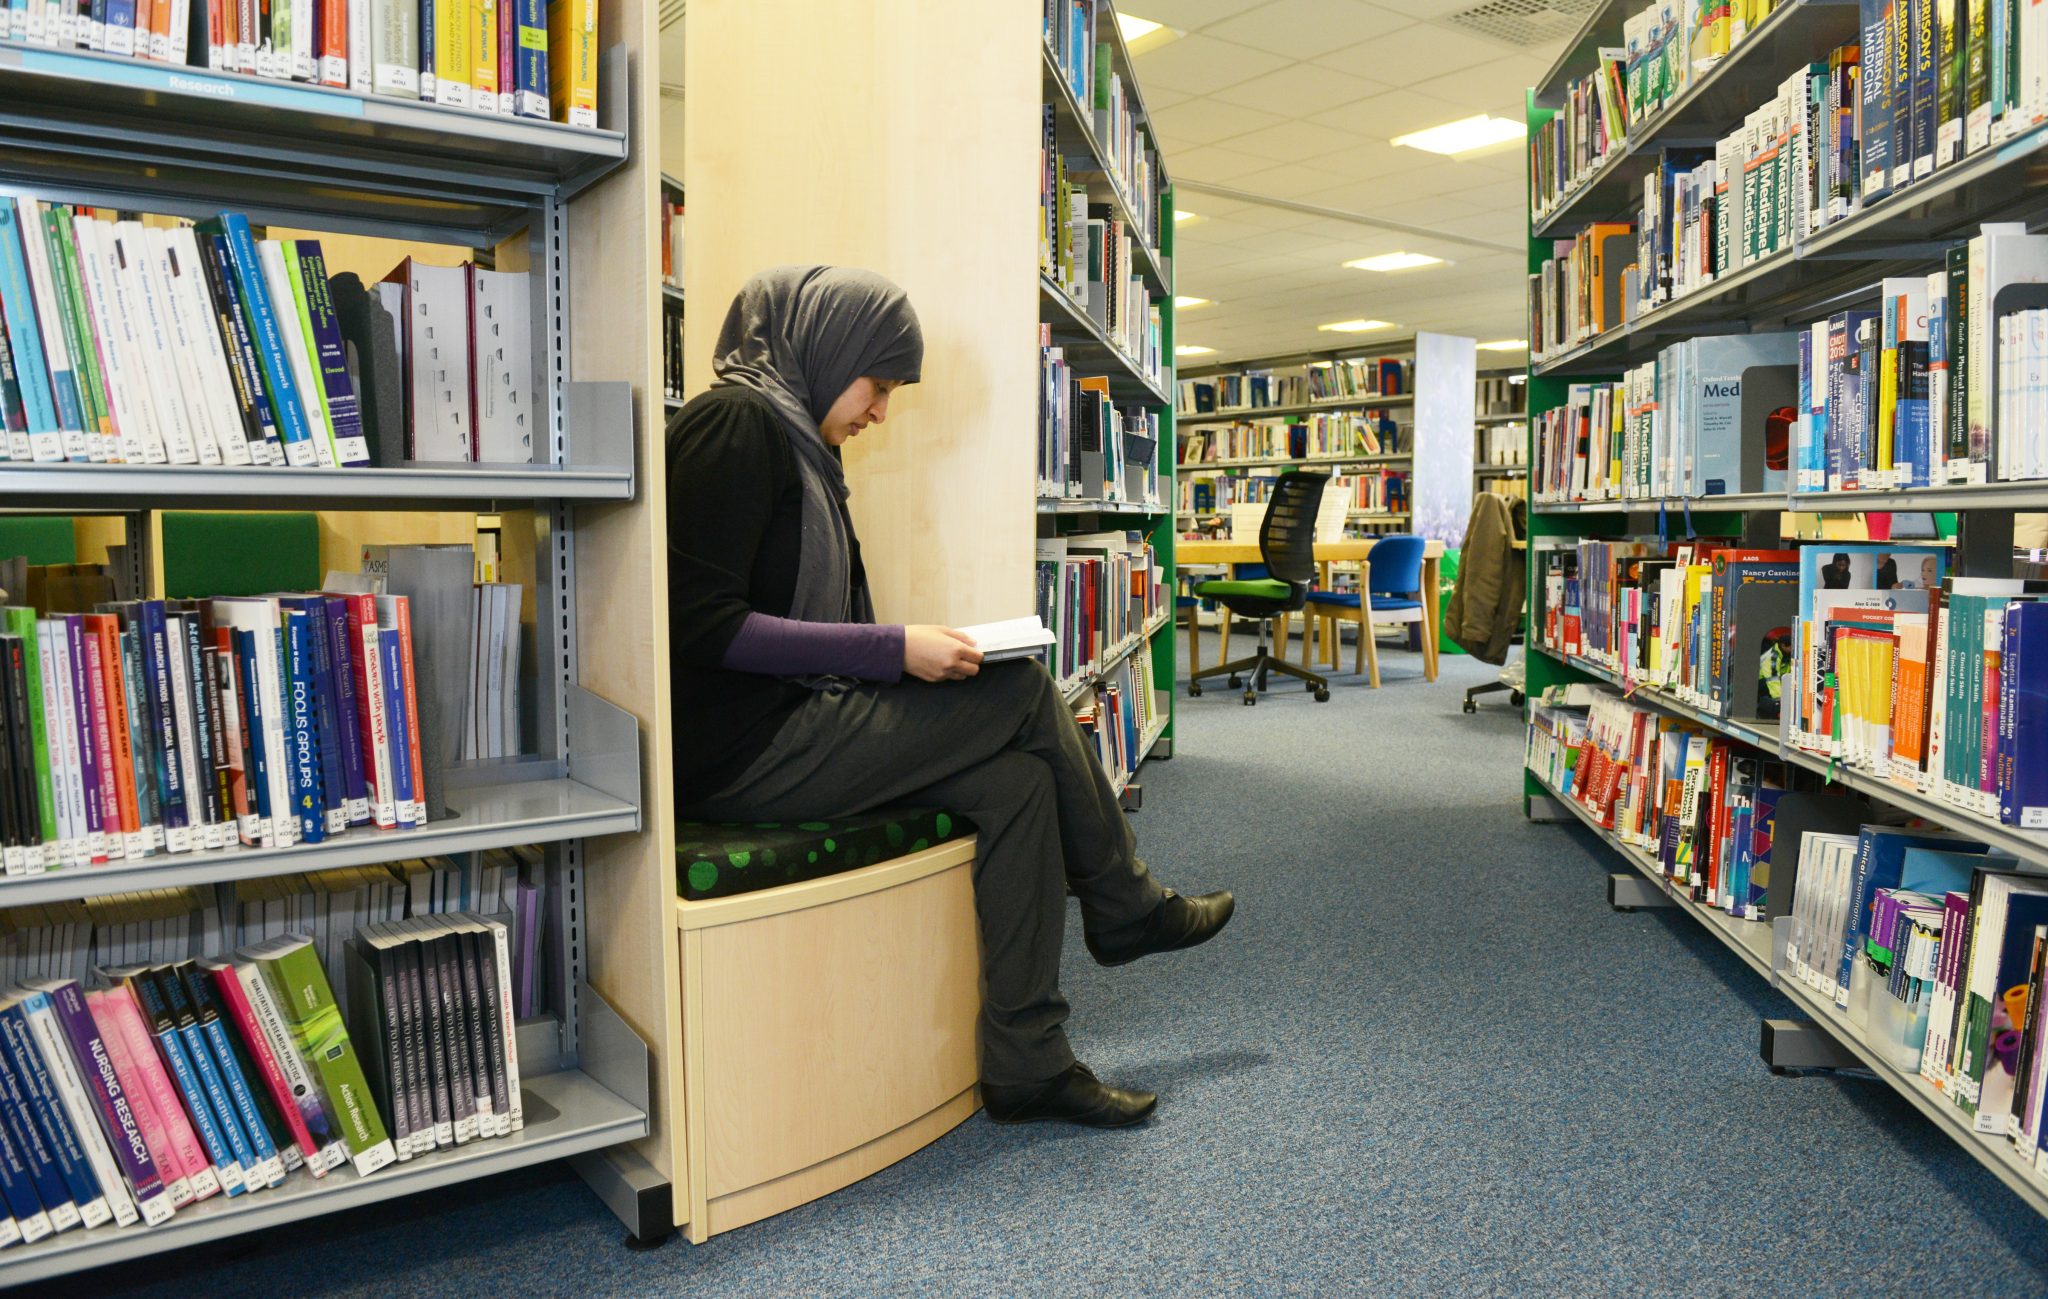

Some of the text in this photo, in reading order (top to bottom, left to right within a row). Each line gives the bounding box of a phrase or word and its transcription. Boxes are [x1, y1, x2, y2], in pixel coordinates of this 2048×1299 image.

[1864, 32, 1875, 106] MEDICINE
[1874, 26, 1884, 99] INTERNAL
[1882, 13, 1893, 110] HARRISON'S
[1899, 0, 1908, 82] ARRISON'S
[1973, 58, 1980, 72] 2
[169, 76, 235, 97] Research
[1942, 74, 1948, 86] 1
[1743, 174, 1755, 256] Medicine
[1758, 166, 1771, 250] Medicine
[1777, 154, 1788, 236] Medicine
[1718, 198, 1728, 271] Medicine
[111, 267, 120, 287] Good
[116, 289, 126, 320] Research
[123, 321, 132, 342] Guide
[237, 228, 289, 389] Informed Consent in Medical Research
[300, 256, 317, 311] and Clinical Trials
[308, 256, 328, 329] Epidemiological Studies
[314, 256, 334, 316] Critical Appraisal of
[142, 274, 150, 292] Good
[146, 296, 156, 326] Research
[154, 330, 163, 350] Guide
[1830, 320, 1845, 332] LANGE
[1830, 334, 1846, 346] CMDT
[233, 302, 249, 343] Research
[243, 343, 263, 397] Methodology
[325, 366, 345, 374] Elwood
[1830, 345, 1845, 359] 2015
[1957, 356, 1965, 390] Physical
[1704, 382, 1740, 398] Med
[1641, 420, 1651, 483] Medicine
[188, 622, 197, 635] A-Z
[335, 616, 351, 697] Qualitative Research
[42, 656, 52, 684] Concise
[129, 620, 145, 704] RESEARCH HANDBOOK
[190, 644, 202, 680] Qualitative
[273, 632, 290, 732] The Researching Therapist
[45, 685, 54, 707] Guide
[47, 708, 55, 716] to
[107, 624, 128, 758] CLINICAL EVIDENCE MADE EASY
[152, 632, 178, 790] RESEARCH METHODS FOR CLINICAL THERAPISTS
[194, 681, 206, 713] Research
[369, 647, 385, 744] research with people
[2008, 689, 2016, 739] Examination
[48, 718, 58, 745] Clinical
[87, 639, 118, 816] ACTION RESEARCH FOR HEALTH AND SOCIAL CARE
[198, 721, 211, 758] Healthcare
[292, 680, 312, 787] FOCUS GROUPS
[51, 746, 60, 766] Trials
[2005, 757, 2013, 791] Ruthven
[54, 774, 65, 817] Allan Hackshaw
[303, 795, 312, 808] 4
[1681, 770, 1691, 820] Textbook
[1686, 768, 1699, 821] Paramedic
[1850, 839, 1870, 931] clinical examination
[250, 978, 300, 1082] QUALITATIVE RESEARCH PRACTICE
[387, 1007, 396, 1026] HOW
[390, 1029, 397, 1039] TO
[246, 1012, 281, 1081] The Literature Review
[391, 1040, 399, 1052] DO
[89, 1038, 149, 1164] NURSING RESEARCH
[126, 1013, 197, 1166] HEALTH SCIENCE RESEARCH PEAT
[164, 1034, 222, 1160] RESEARCH HEALTH SCIENCES
[392, 1060, 403, 1096] RESEARCH
[340, 1084, 369, 1142] Action Research
[397, 1098, 407, 1128] PROJECT
